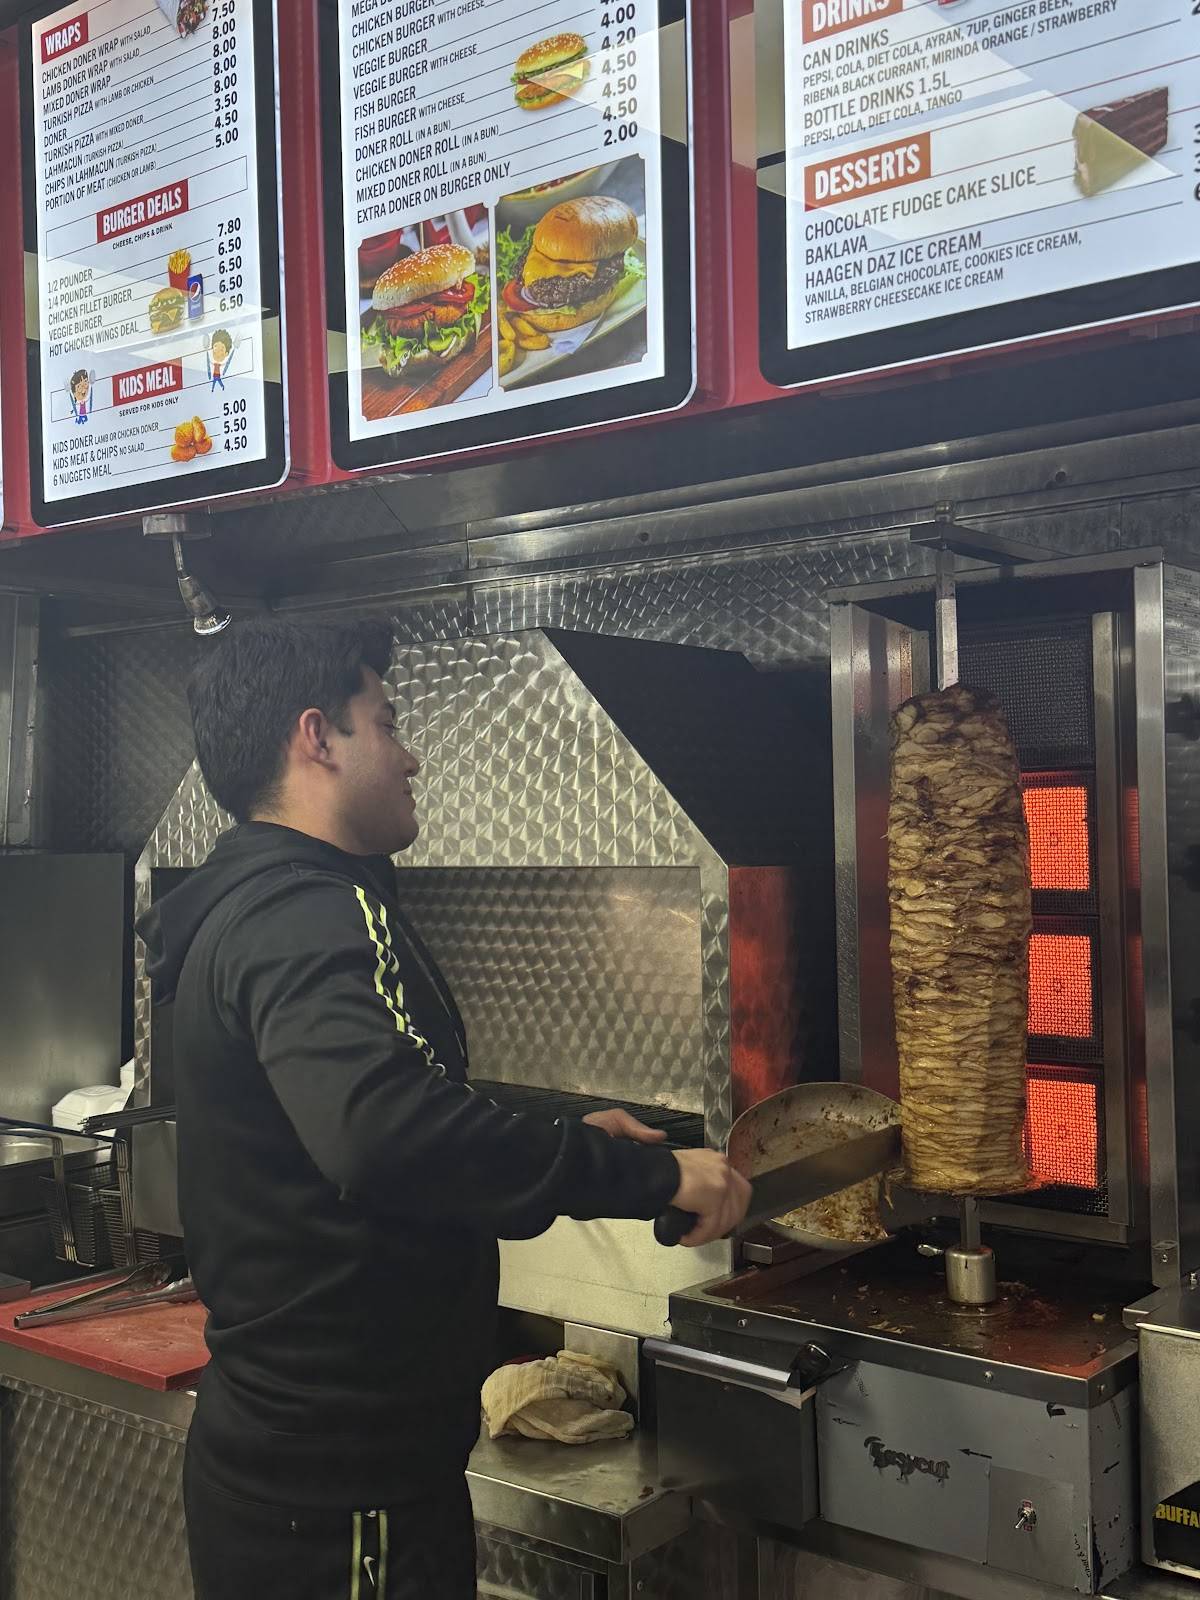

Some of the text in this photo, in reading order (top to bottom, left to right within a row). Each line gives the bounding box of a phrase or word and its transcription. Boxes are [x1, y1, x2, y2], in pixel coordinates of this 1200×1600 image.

[212, 0, 235, 21] 7.50
[352, 9, 392, 38] CHICKEN
[600, 3, 635, 28] 4.00
[45, 22, 81, 55] WRAPS
[212, 18, 235, 40] 8.00
[352, 8, 455, 58] CHICKEN BURGER WITH
[601, 26, 635, 50] 4.20
[42, 37, 118, 83] CHICKEN DONER WRAP
[213, 36, 236, 57] 8.00
[352, 38, 427, 79] VEGGIE BURGER
[803, 4, 1036, 89] PEPSI, COLA, DIET COLA, AYRAN, 7UP, GINGER
[803, 28, 888, 71] CAN DRINKS
[804, 0, 1118, 106] RIBENA BLACK CURRANT, MIRINDA ORANGE STRAWBERRY
[214, 54, 236, 76] 8.00
[353, 43, 477, 100] VEGGIE BURGER WITH CHEESE
[601, 50, 636, 75] 4.50
[42, 59, 108, 99] LAMB DONER WRAP
[66, 75, 110, 106] DONER WRAP
[214, 72, 237, 93] 8.00
[602, 74, 636, 98] 4.50
[214, 91, 237, 112] 3.50
[354, 85, 415, 120] FISH BURGER
[602, 97, 637, 122] 4.50
[804, 71, 950, 129] BOTTLE DRINKS 1.5L
[43, 100, 93, 132] TURKISH PIZZA
[214, 109, 237, 129] 4.50
[355, 92, 465, 141] FISH BURGER WITH CHEESE
[804, 89, 962, 147] PEPSI, COLA, DIET COLA, TANGO
[44, 128, 67, 147] DONER
[44, 132, 94, 163] TURKISH PIZZA
[216, 127, 238, 148] 5.00
[355, 130, 413, 161] DONER ROLL
[604, 121, 637, 146] 2.00
[44, 154, 82, 179] LAHMACUN
[356, 135, 460, 182] CHICKEN DONER ROLL
[815, 143, 920, 200] DESSERTS
[45, 157, 114, 195] CHIPS IN LAHMACUN
[356, 161, 448, 203] MIXED DONER ROLL
[46, 177, 105, 211] PORTION OF MEAT
[357, 161, 510, 224] EXTRA DONER ON BURGER ONLY
[805, 166, 1035, 241] CHOCOLATE FUDGE CAKE SLICE
[103, 187, 181, 235] BURGER DEALS
[218, 217, 240, 237] 7.80
[218, 236, 241, 255] 6.50
[806, 235, 867, 265] BAKLAVA
[806, 230, 981, 289] HAAGEN DAZ ICE CREAM
[218, 255, 241, 274] 6.50
[805, 231, 1081, 306] VANILLA, BELGIAN CHOCOLATE, COOKIES ICE CREAM,
[48, 268, 92, 293] 1/2 POUNDER
[219, 274, 242, 293] 6.50
[48, 284, 93, 309] 1/4 POUNDER
[48, 288, 132, 325] CHICKEN FILLET BURGER
[220, 293, 243, 311] 6.50
[805, 267, 1003, 324] STRAWBERRY CHEESECAKE ICE CREAM
[48, 314, 102, 341] VEGGIE BURGER
[49, 320, 139, 357] HOT CHICKEN WINGS DEAL
[119, 366, 176, 399] KIDS MEAL
[223, 398, 246, 416] 5.00
[224, 417, 246, 434] 5.50
[52, 434, 93, 454] KIDS DONER
[53, 445, 118, 469] KIDS MEAT & CHIPS
[224, 435, 247, 451] 4.50
[53, 463, 111, 486] 6 NUGGETS MEAL
[1154, 1503, 1200, 1529] BUFFA
